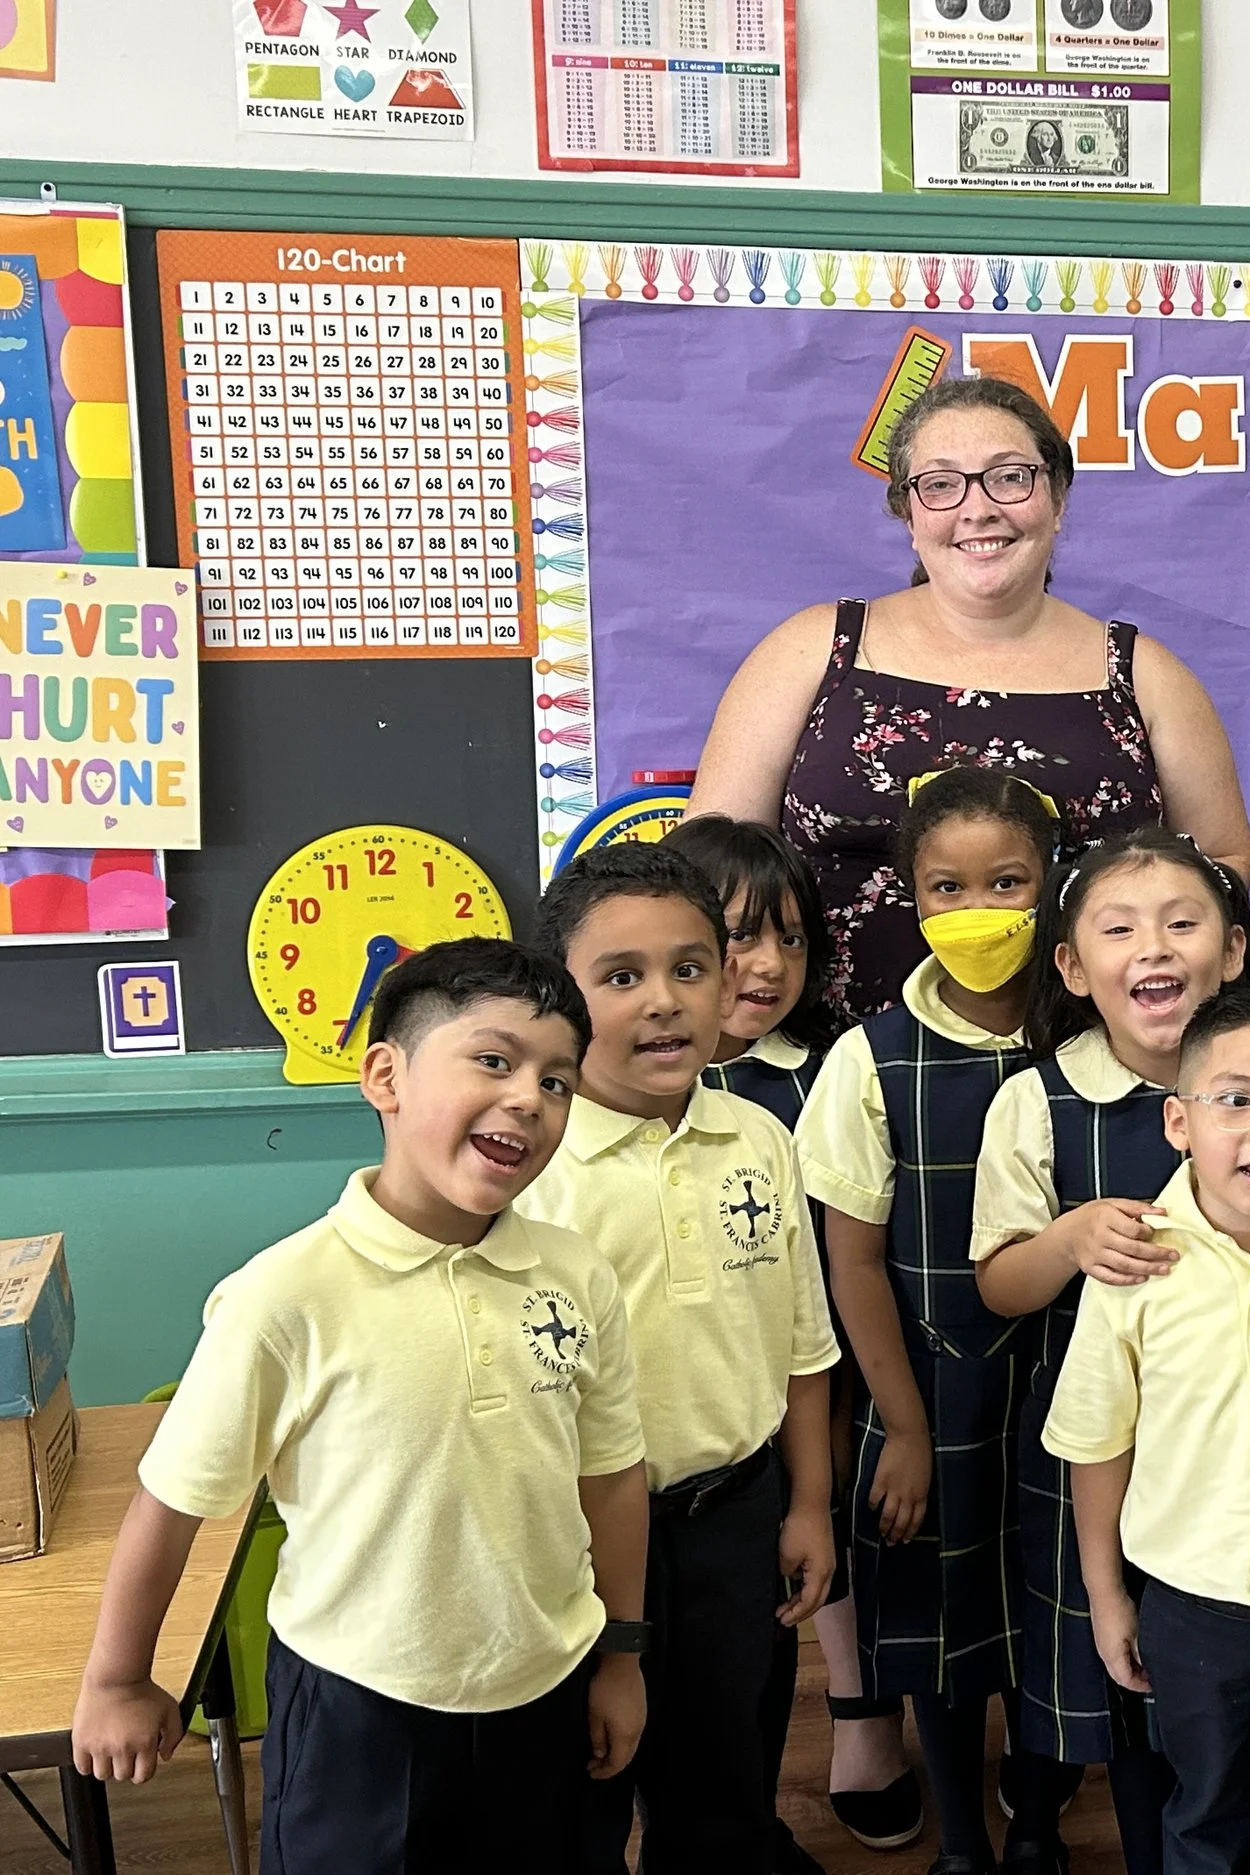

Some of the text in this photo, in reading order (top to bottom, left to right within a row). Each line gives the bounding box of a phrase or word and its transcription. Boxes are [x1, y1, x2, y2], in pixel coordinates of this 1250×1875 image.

[924, 31, 1024, 42] 10 Dimes One Dollar
[1055, 35, 1159, 47] 4 Quarters One Dollar
[245, 42, 457, 64] PENTAGON STAR DIAMOND
[1092, 55, 1132, 63] Washington
[576, 57, 592, 66] nine
[623, 59, 653, 69] 10: ten
[674, 61, 716, 72] 11: eleven
[950, 57, 968, 65] front
[731, 64, 774, 74] 12: twelve
[951, 80, 1131, 98] ONE DOLLAR BILL $1.00
[246, 104, 465, 126] RECTANGLE HEART TRAPEZOID
[928, 176, 959, 187] George
[960, 177, 1009, 187] Washington
[1010, 178, 1018, 186] is
[1033, 178, 1046, 187] the
[1048, 178, 1070, 188] front
[1070, 179, 1080, 188] of
[1081, 180, 1095, 188] the
[1114, 181, 1138, 190] dollar
[1139, 181, 1155, 190] bill.
[276, 247, 407, 273] 120-Chart
[194, 290, 495, 309] 1 2 3 4 5 6 7 8 9 10
[194, 322, 498, 340] 11 12 13 14 15 16 17 18 19 20
[212, 626, 389, 641] 111 112 113 114 115 116
[0, 674, 174, 745] HURT
[372, 835, 385, 844] 60
[312, 852, 325, 860] 55
[435, 846, 441, 855] 5
[364, 849, 397, 876] 12
[322, 861, 435, 891] 11 1
[478, 886, 488, 895] 10
[269, 895, 282, 904] 50
[287, 892, 474, 925] 10 2
[255, 951, 268, 960] 45
[280, 943, 300, 971] 9
[297, 988, 317, 1016] 8
[275, 1007, 288, 1016] 40
[320, 1046, 333, 1055] 35
[721, 1167, 771, 1193] ST. BRIGID
[719, 1193, 783, 1252] ST. FRANCES CABRINI
[522, 1289, 575, 1313] ST. BRIGID
[520, 1319, 531, 1339] ST.
[529, 1341, 576, 1374] FRANCES
